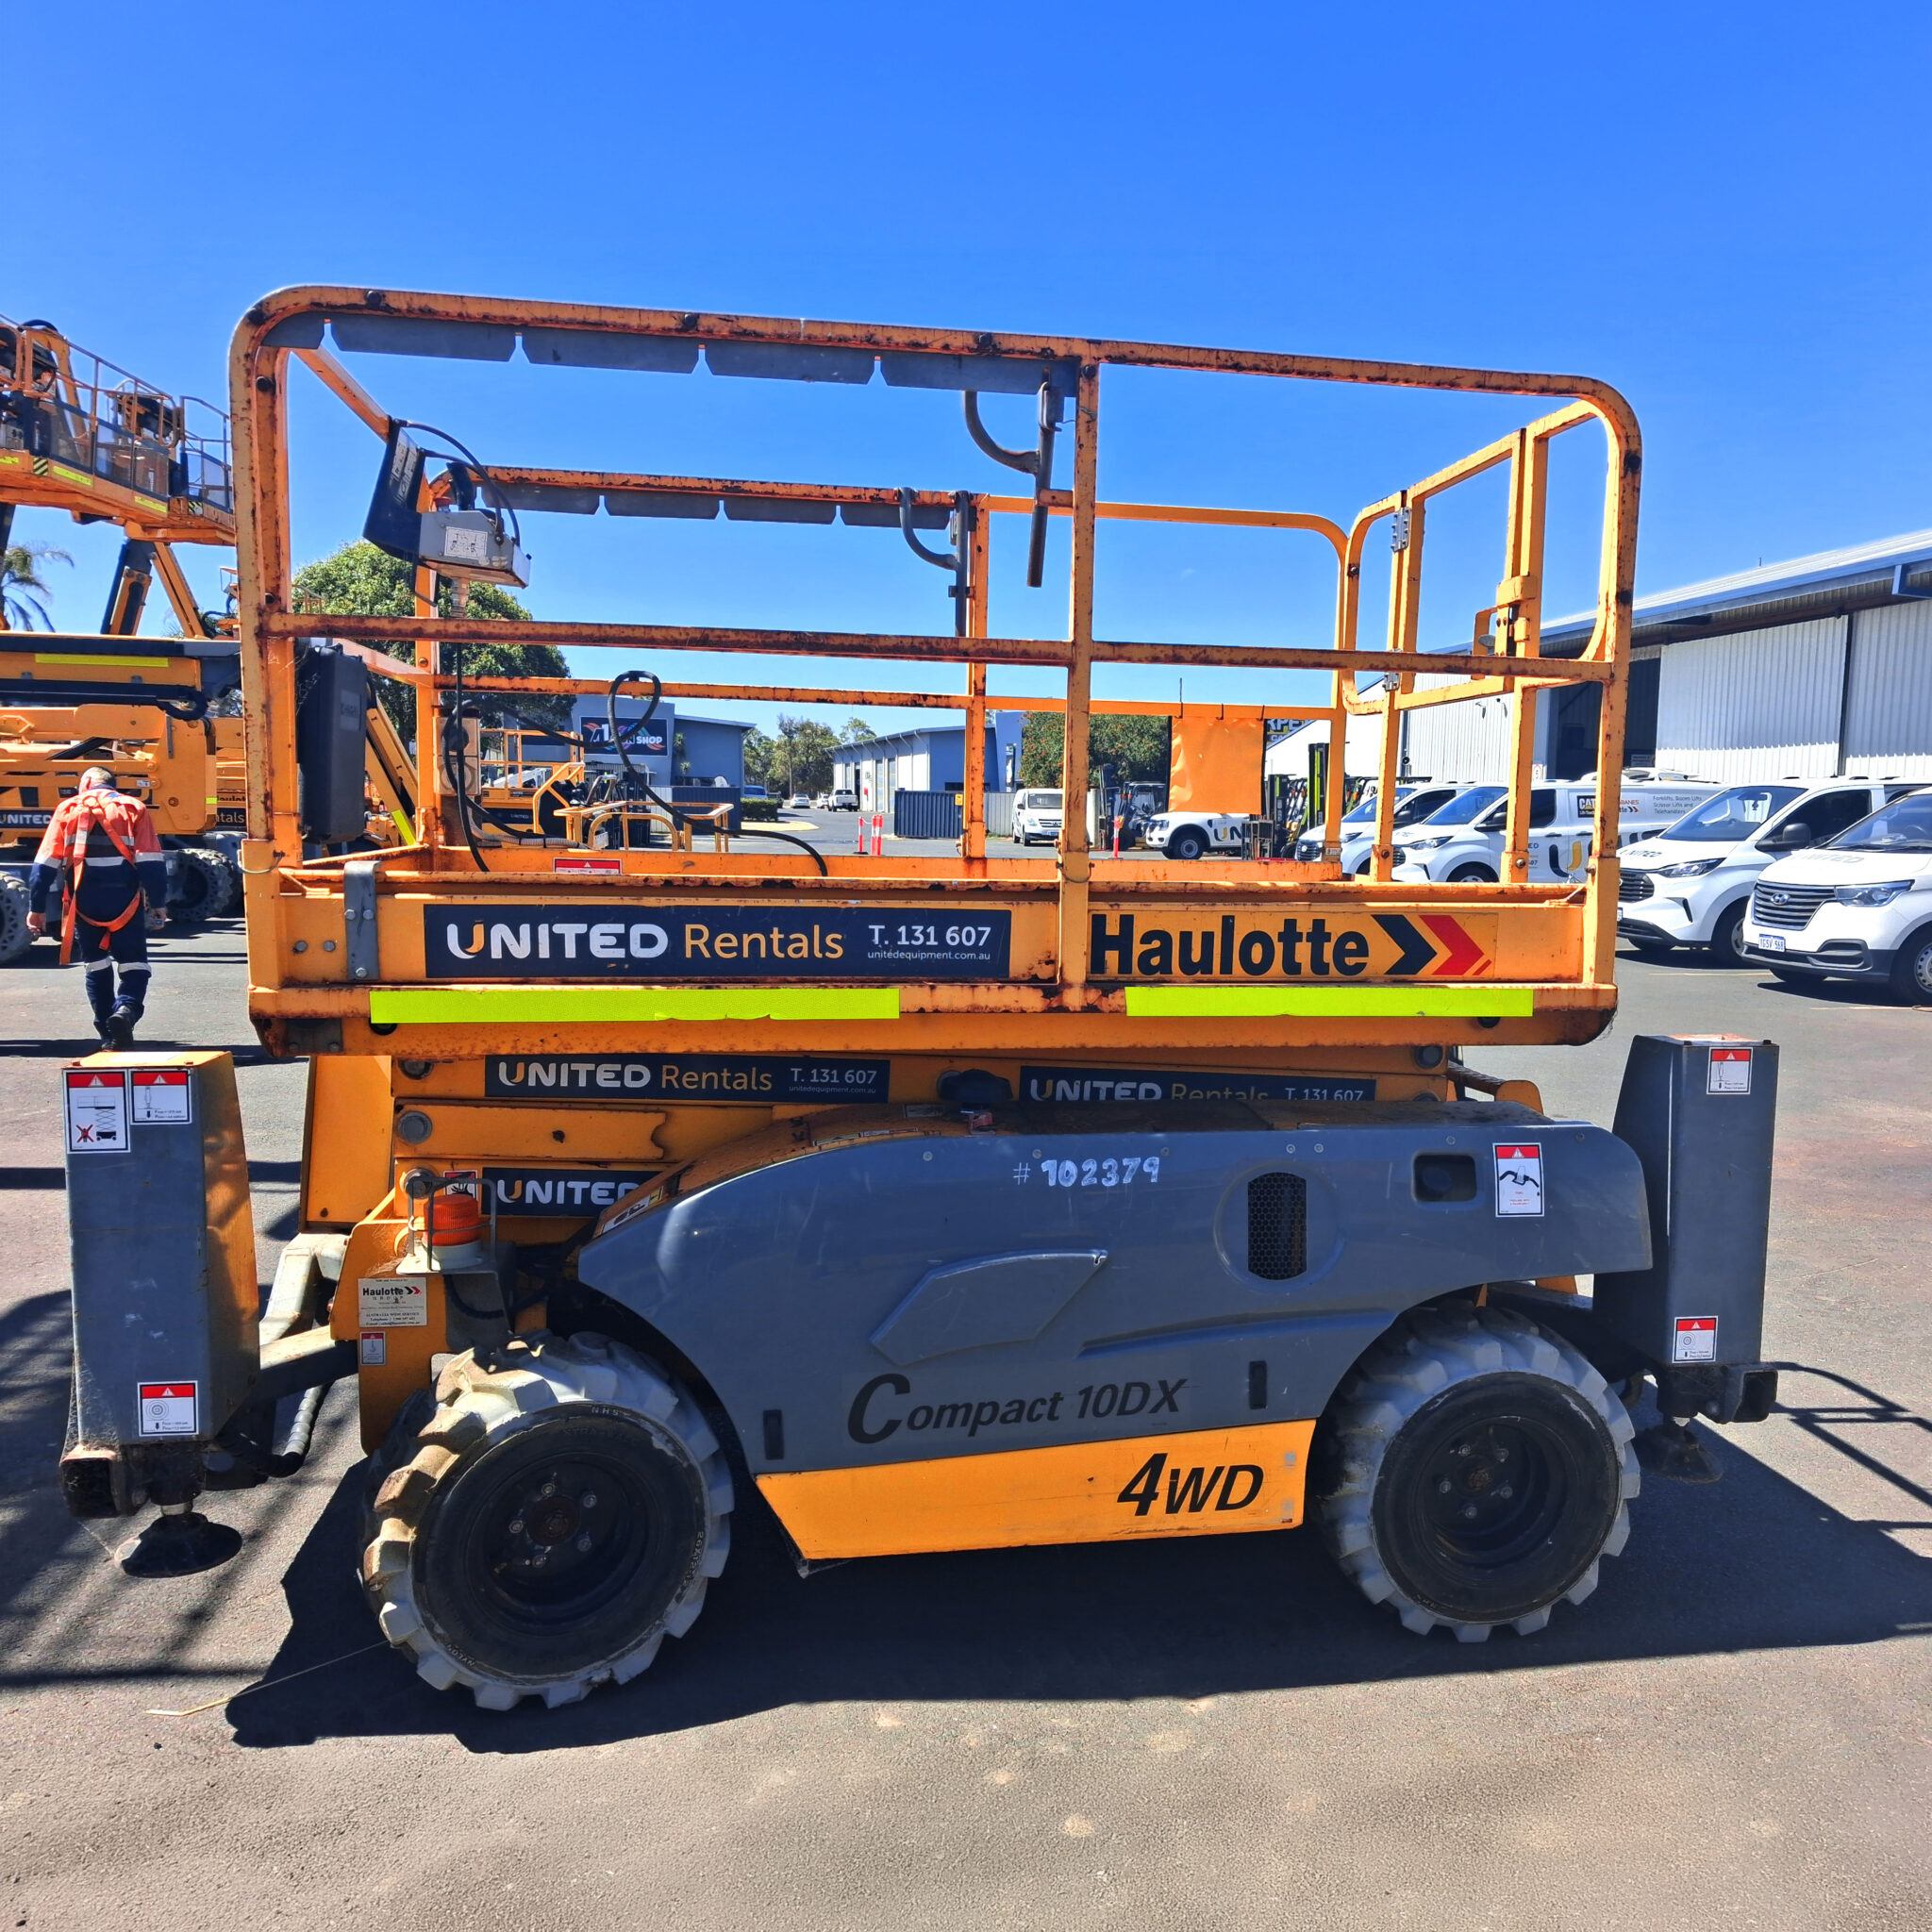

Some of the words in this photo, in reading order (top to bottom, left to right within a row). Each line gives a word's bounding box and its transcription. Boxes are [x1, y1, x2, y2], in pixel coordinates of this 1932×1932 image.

[636, 736, 663, 744] SHOP
[1578, 798, 1595, 810] CAT
[447, 924, 668, 958] UNITED
[685, 924, 843, 958] Rentals
[869, 925, 889, 945] T.
[897, 925, 938, 945] 131
[946, 926, 991, 946] 607
[1091, 914, 1369, 975] Haulotte
[868, 950, 991, 961] unitedequipment.com.au
[499, 1062, 651, 1088] UNITED
[662, 1065, 773, 1091] Rentals
[791, 1068, 805, 1082] T.
[810, 1069, 840, 1083] 131
[845, 1070, 877, 1084] 607
[789, 1086, 876, 1094] unitedequipment.com.au
[1030, 1079, 1162, 1101] UNITED
[1303, 1089, 1328, 1101] 131
[1041, 1157, 1159, 1187] 102379
[363, 1288, 404, 1296] Haulotte
[848, 1374, 1064, 1443] Compact
[1077, 1379, 1188, 1419] 10DX
[1117, 1453, 1264, 1516] 4WD
